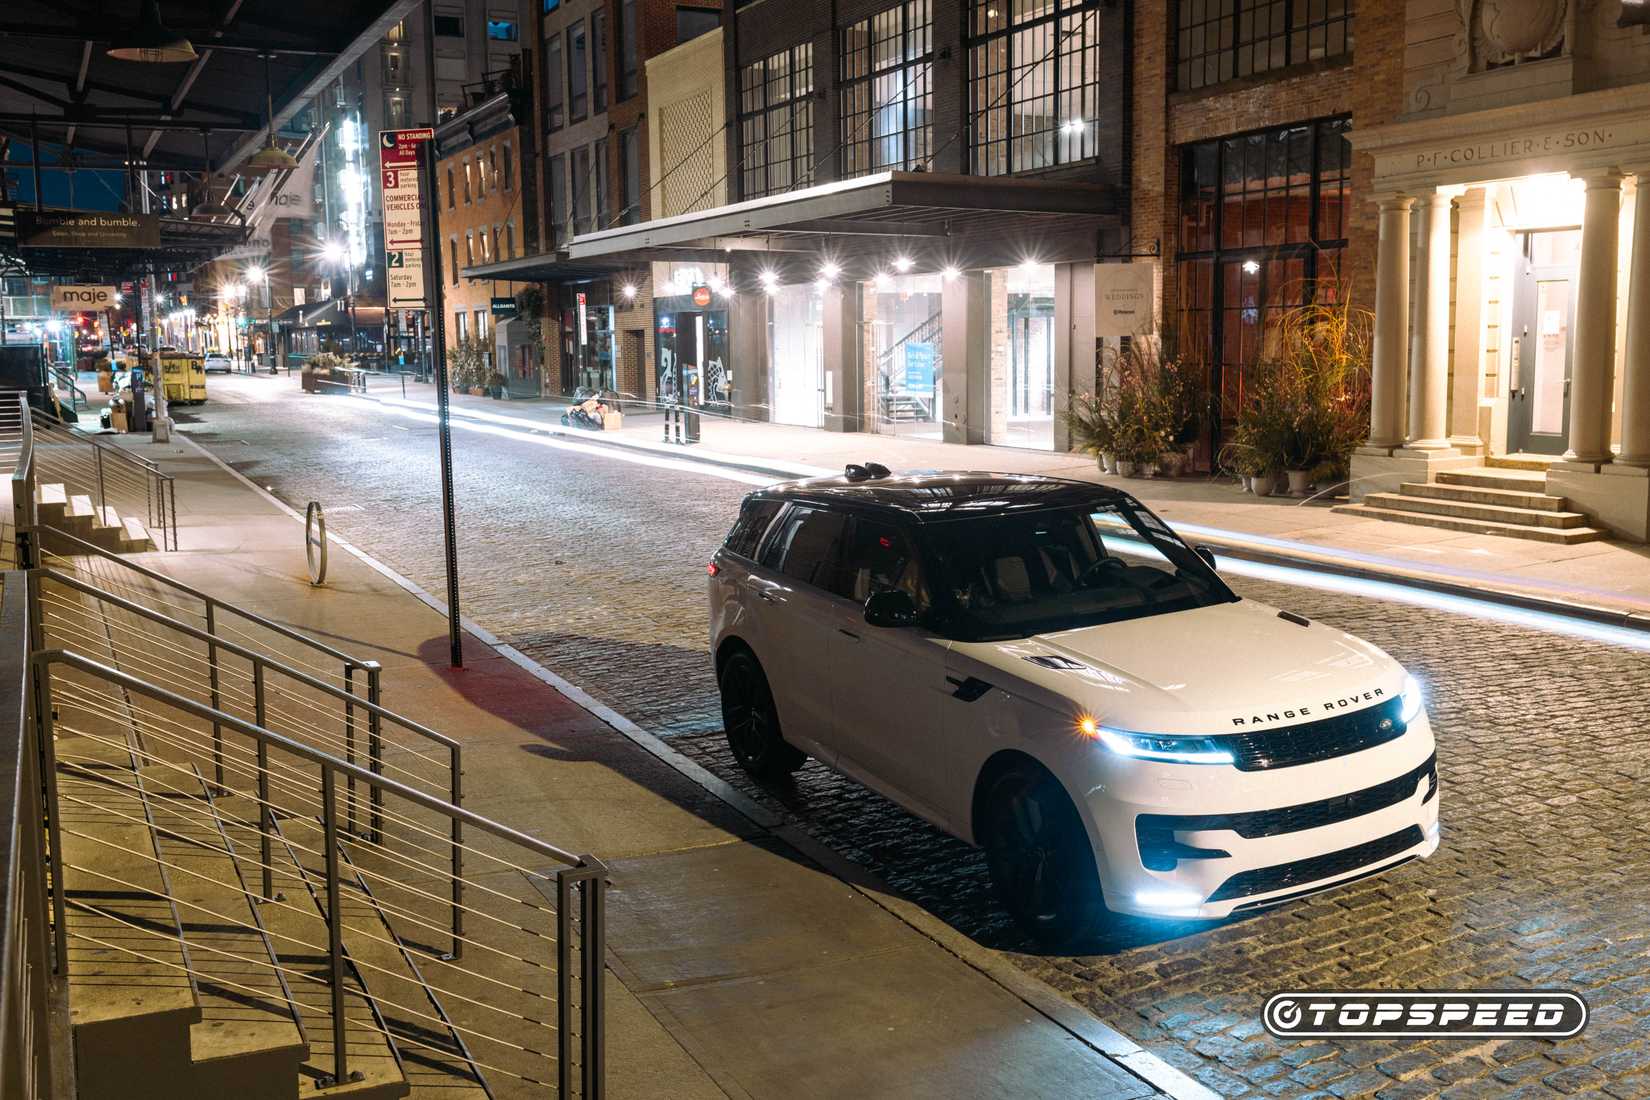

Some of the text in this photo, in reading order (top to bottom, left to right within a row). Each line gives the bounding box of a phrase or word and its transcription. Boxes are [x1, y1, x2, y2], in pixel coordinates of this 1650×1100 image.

[406, 132, 431, 140] STANDING
[386, 171, 396, 188] 3
[78, 217, 97, 226] and
[391, 251, 400, 267] 2
[63, 288, 108, 305] maje
[1231, 687, 1385, 727] RANGE ROVER
